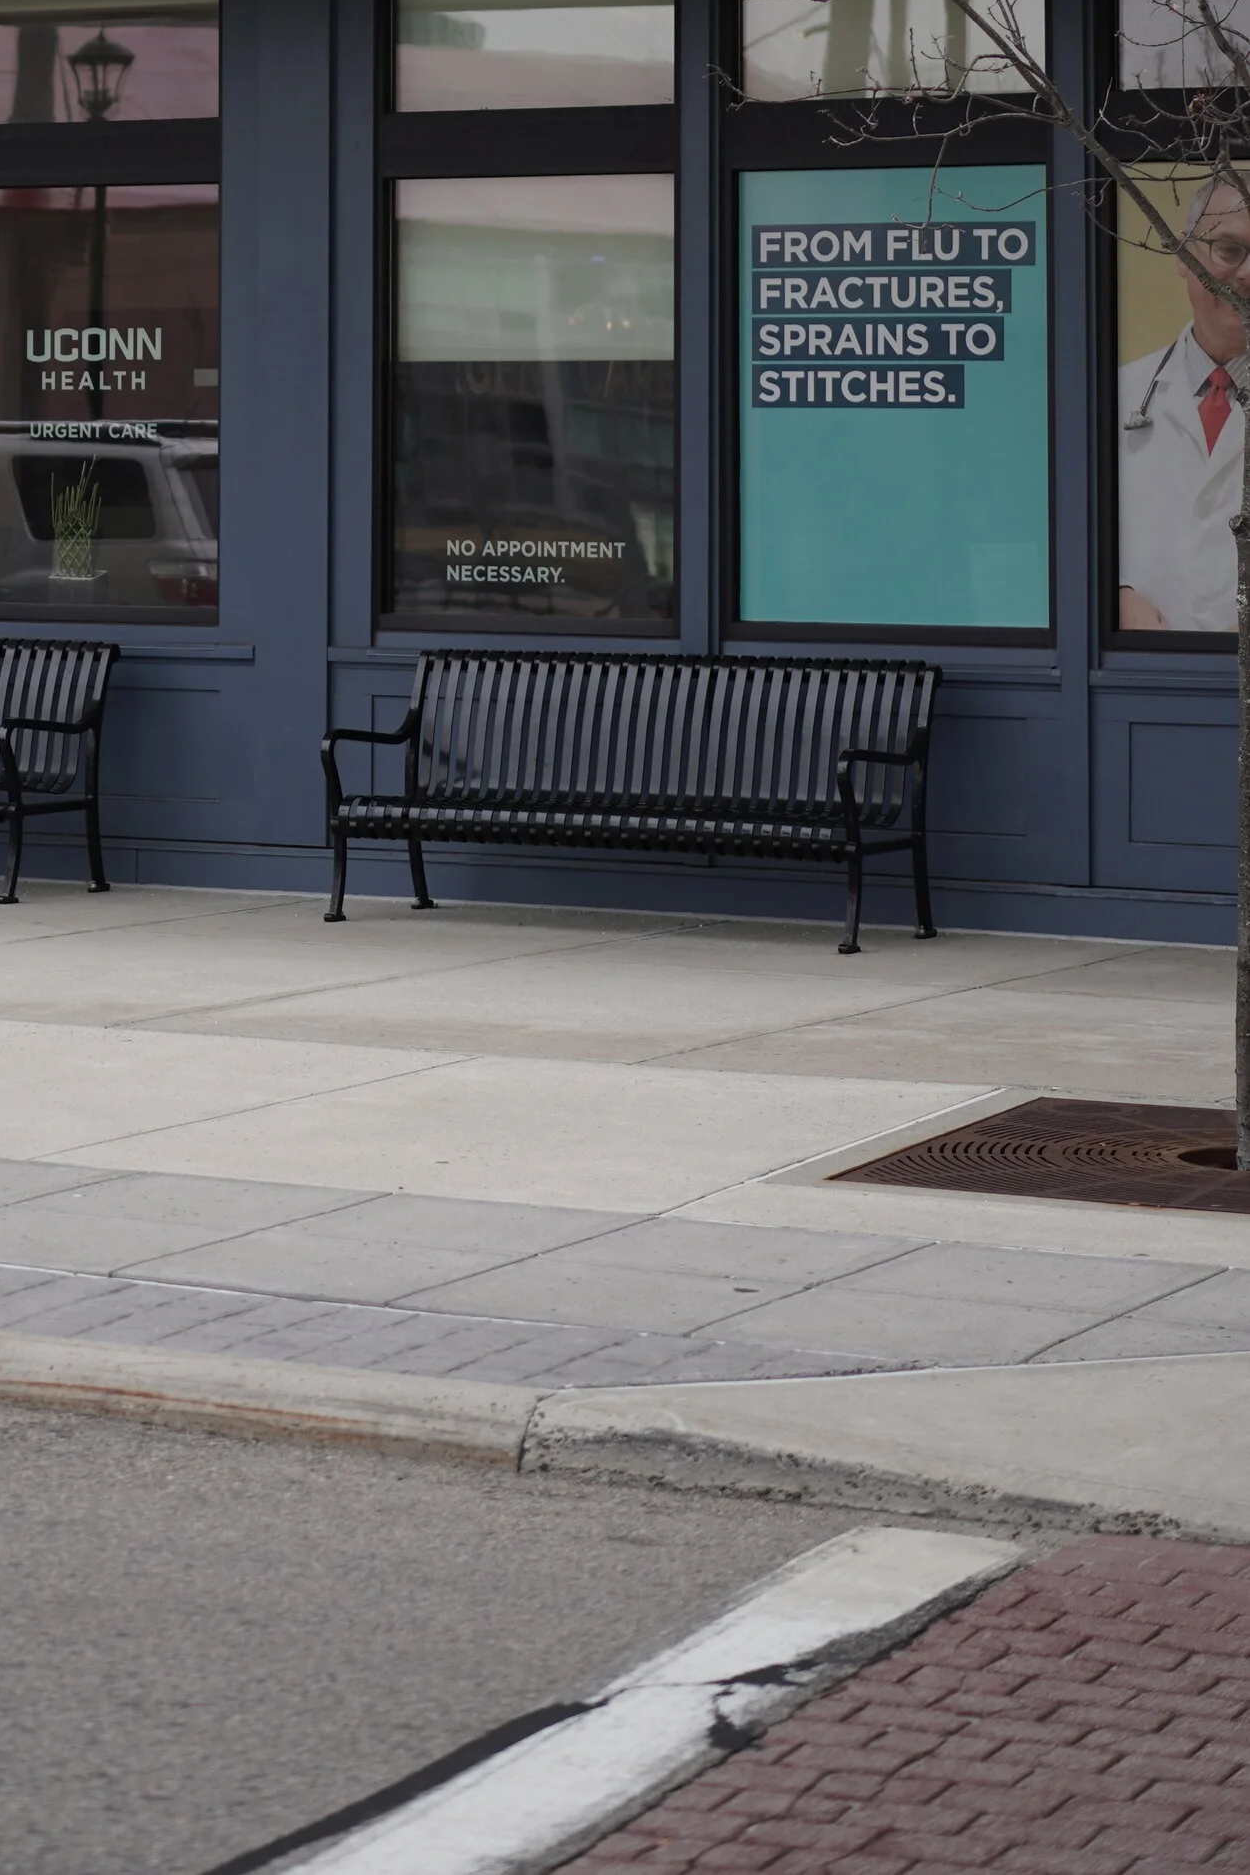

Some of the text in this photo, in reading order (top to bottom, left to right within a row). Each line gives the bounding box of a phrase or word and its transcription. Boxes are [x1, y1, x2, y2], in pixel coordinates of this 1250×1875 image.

[760, 227, 1029, 263] FROM FLU TO
[760, 275, 1004, 313] FRACTURES,
[26, 327, 162, 363] UCONN
[758, 322, 997, 356] SPRAINS TO
[41, 371, 146, 391] HEALTH
[758, 370, 956, 403] STITCHES.
[30, 423, 158, 439] URGENT CARE
[446, 540, 626, 559] NO APPOINTMENT
[446, 565, 566, 583] NECESSARY.
